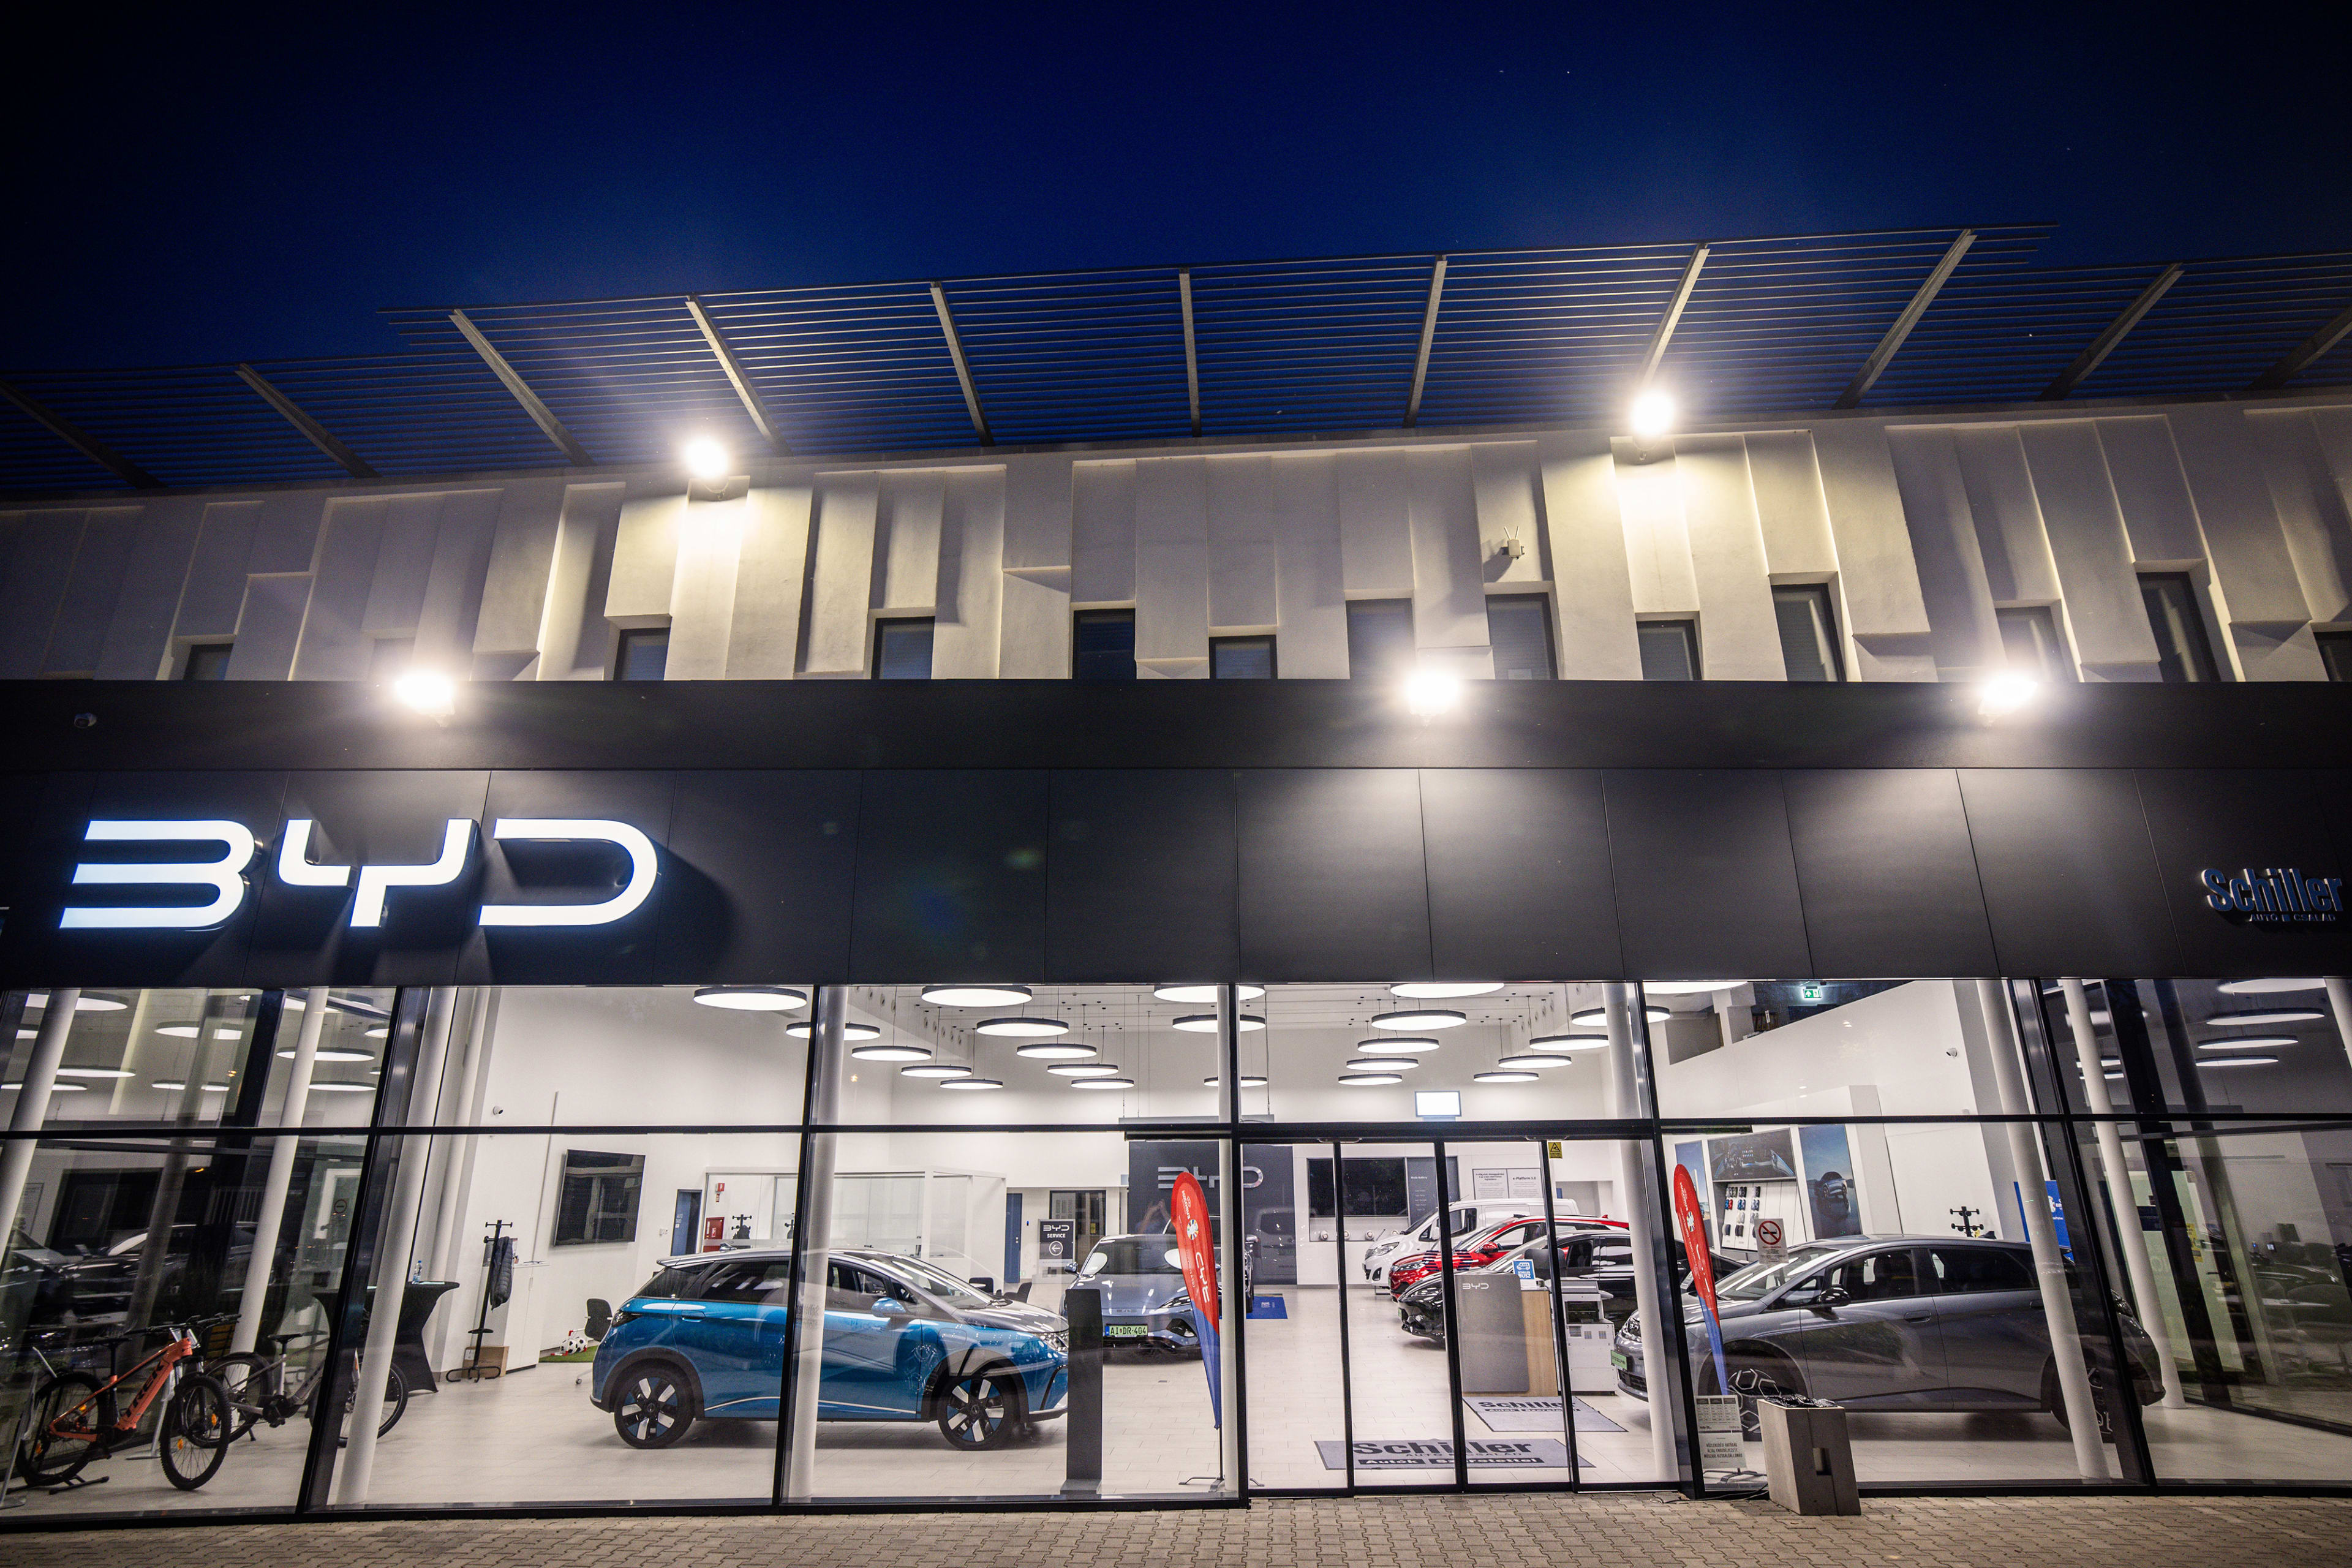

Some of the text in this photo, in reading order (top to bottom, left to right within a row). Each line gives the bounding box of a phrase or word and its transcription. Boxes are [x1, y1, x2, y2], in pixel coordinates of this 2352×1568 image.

[59, 818, 658, 929] BYD
[2201, 868, 2343, 912] Schiller
[126, 1361, 164, 1418] TREK
[1353, 1441, 1531, 1455] Schiler
